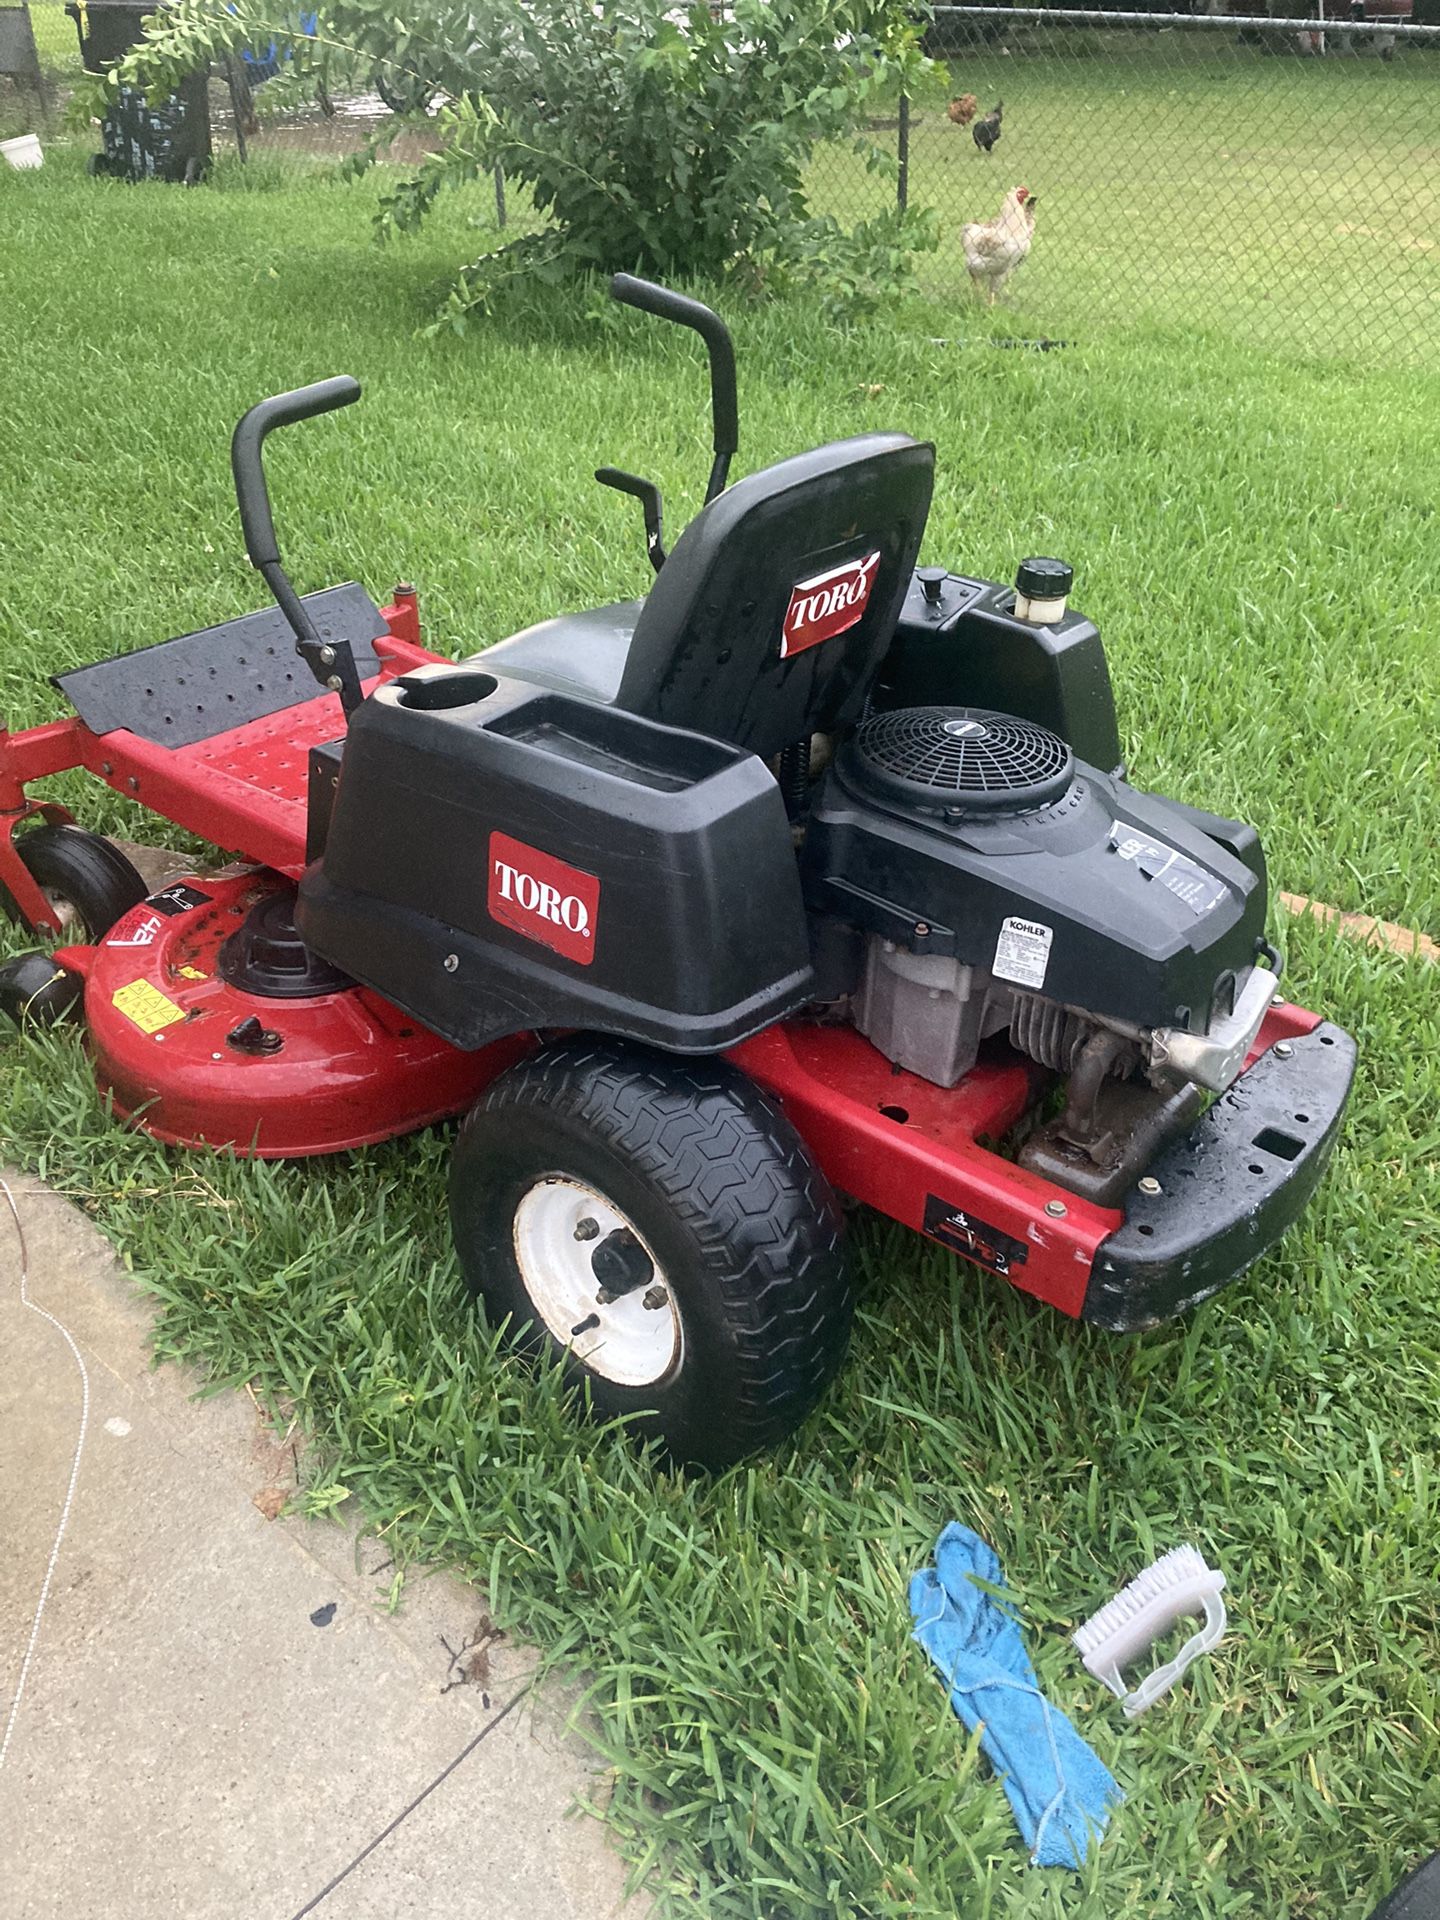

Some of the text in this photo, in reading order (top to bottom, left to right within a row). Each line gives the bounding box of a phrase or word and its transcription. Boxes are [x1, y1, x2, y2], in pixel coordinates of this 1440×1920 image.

[790, 574, 867, 631] TORO
[494, 859, 589, 933] TORO
[1009, 920, 1046, 938] KOHLER
